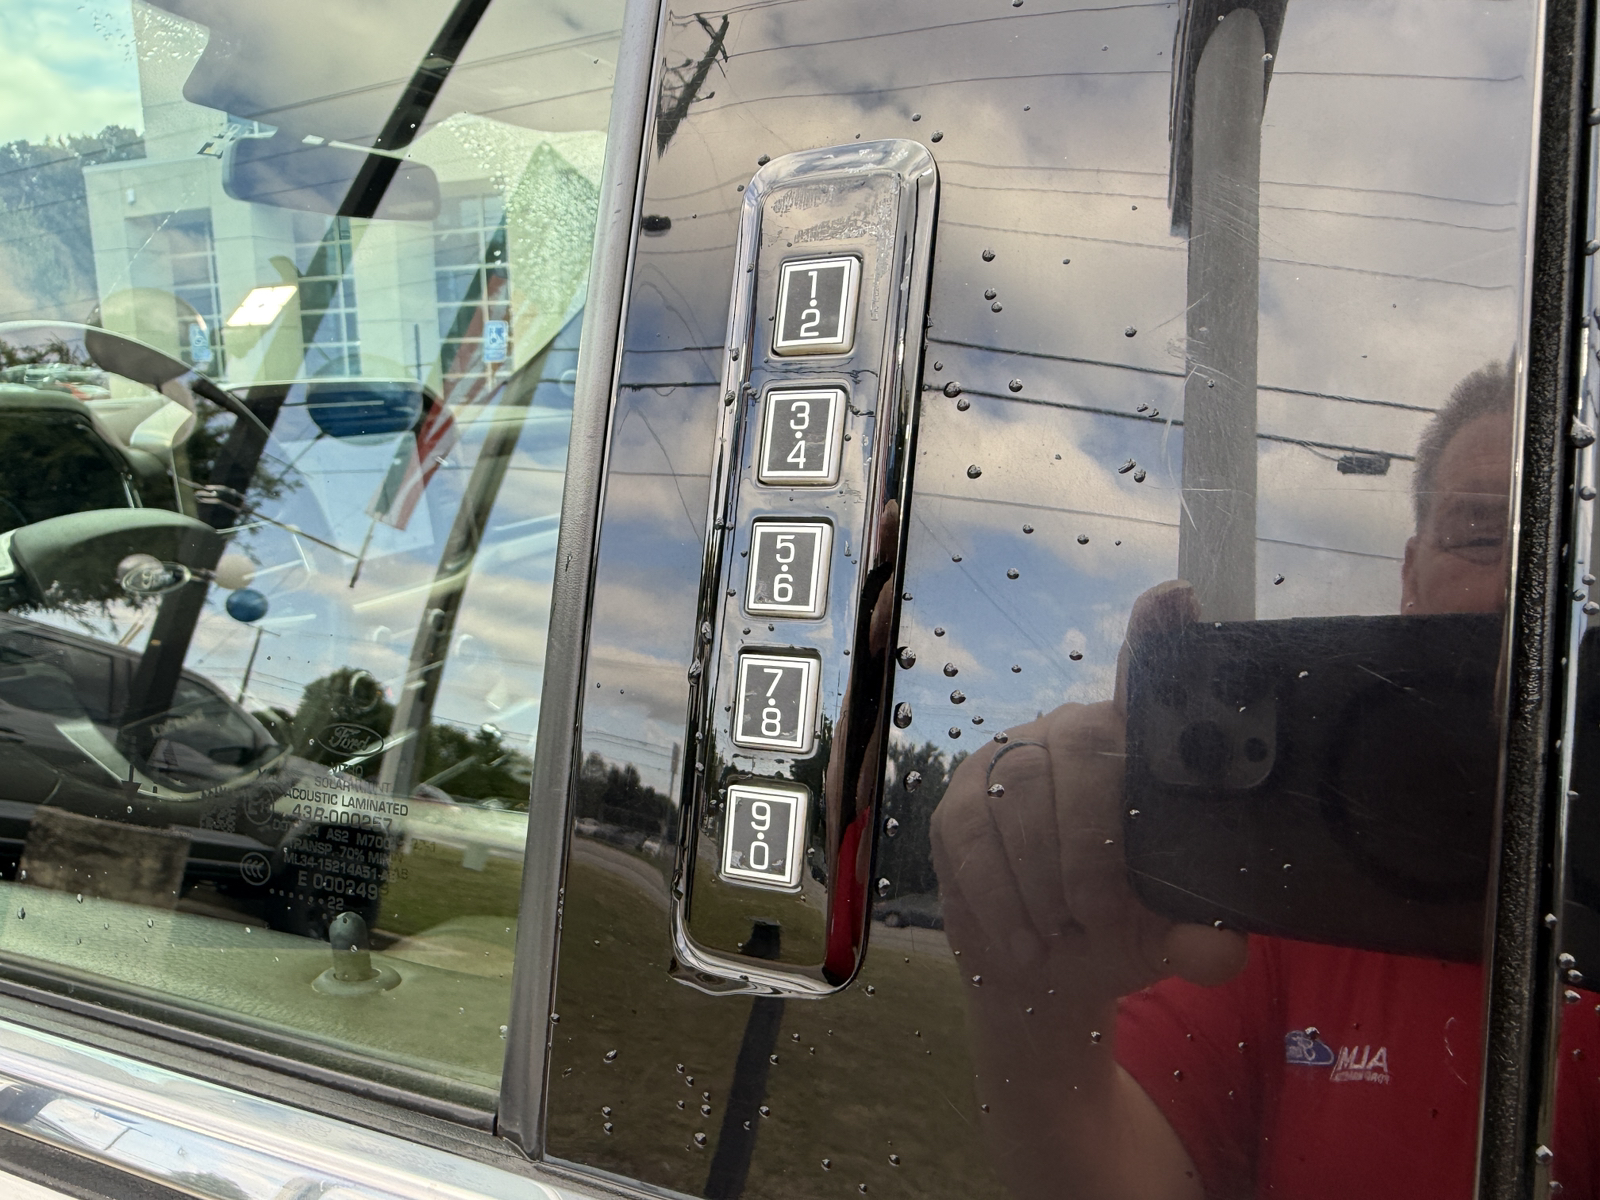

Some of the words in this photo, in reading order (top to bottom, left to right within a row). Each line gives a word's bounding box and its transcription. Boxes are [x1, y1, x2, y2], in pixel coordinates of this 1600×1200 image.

[807, 270, 818, 299] 1
[800, 308, 821, 337] 2
[789, 401, 811, 430] 3
[786, 440, 807, 469] 4
[775, 535, 796, 564] 5
[773, 573, 794, 602] 6
[763, 668, 783, 697] 7
[760, 707, 782, 736] 8
[329, 726, 371, 751] Ford
[315, 776, 351, 792] SOLAR
[285, 785, 338, 806] ACOUSTIC
[342, 794, 409, 817] LAMINATED
[751, 801, 771, 831] 9
[326, 827, 349, 844] AS2
[340, 846, 365, 863] 70%
[749, 841, 770, 870] 0
[298, 870, 308, 887] E
[327, 895, 345, 911] 22
